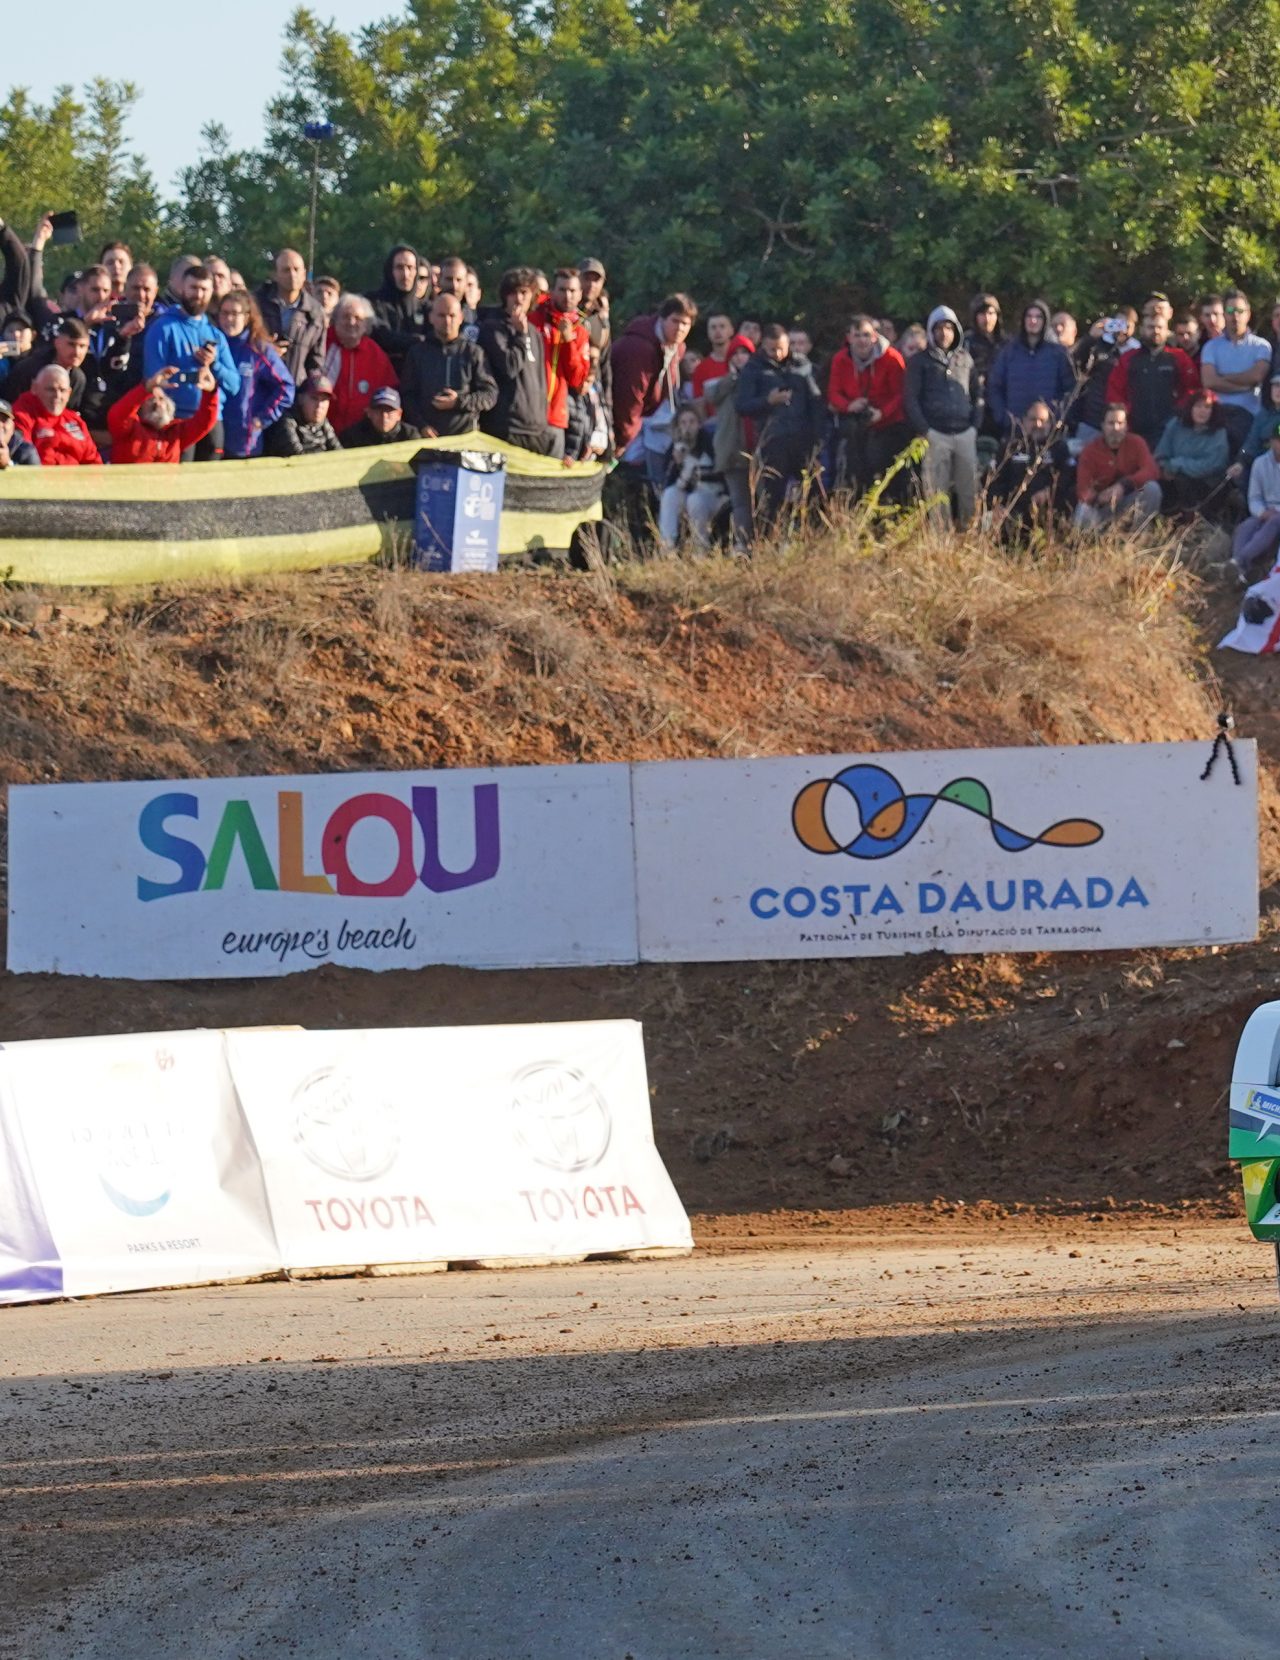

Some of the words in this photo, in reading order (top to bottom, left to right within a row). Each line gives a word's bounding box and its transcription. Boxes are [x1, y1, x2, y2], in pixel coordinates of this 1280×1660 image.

[137, 783, 501, 902] SALOU
[749, 884, 904, 920] COSTA
[918, 876, 1150, 914] DAURADA
[222, 928, 330, 961] europe's
[337, 918, 417, 951] beach
[305, 1195, 436, 1231] TOYOTA
[519, 1185, 647, 1223] TOYOTA
[127, 1240, 158, 1254] PARKS
[167, 1238, 202, 1251] RESORT
